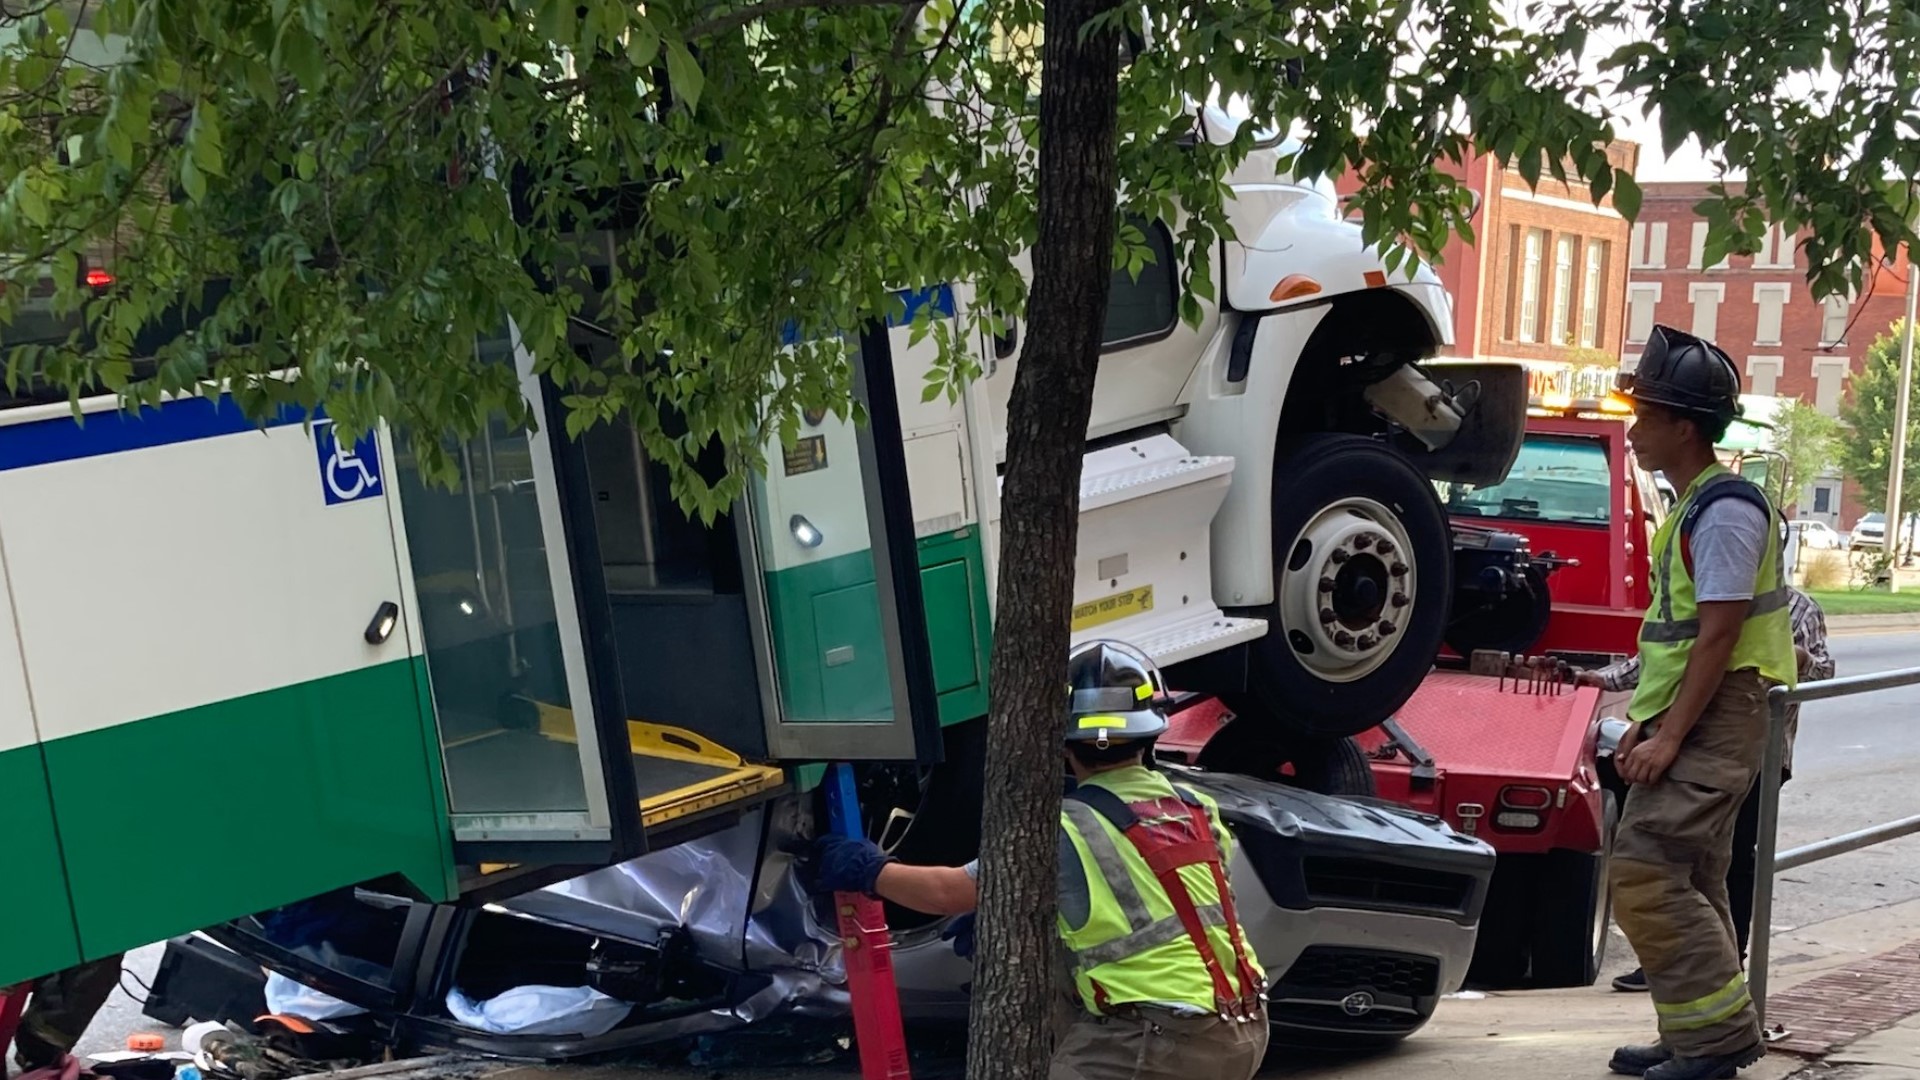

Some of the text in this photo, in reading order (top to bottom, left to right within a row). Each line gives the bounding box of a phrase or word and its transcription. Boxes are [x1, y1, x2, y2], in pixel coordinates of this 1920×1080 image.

[1074, 593, 1134, 619] WATCH YOUR STEP
